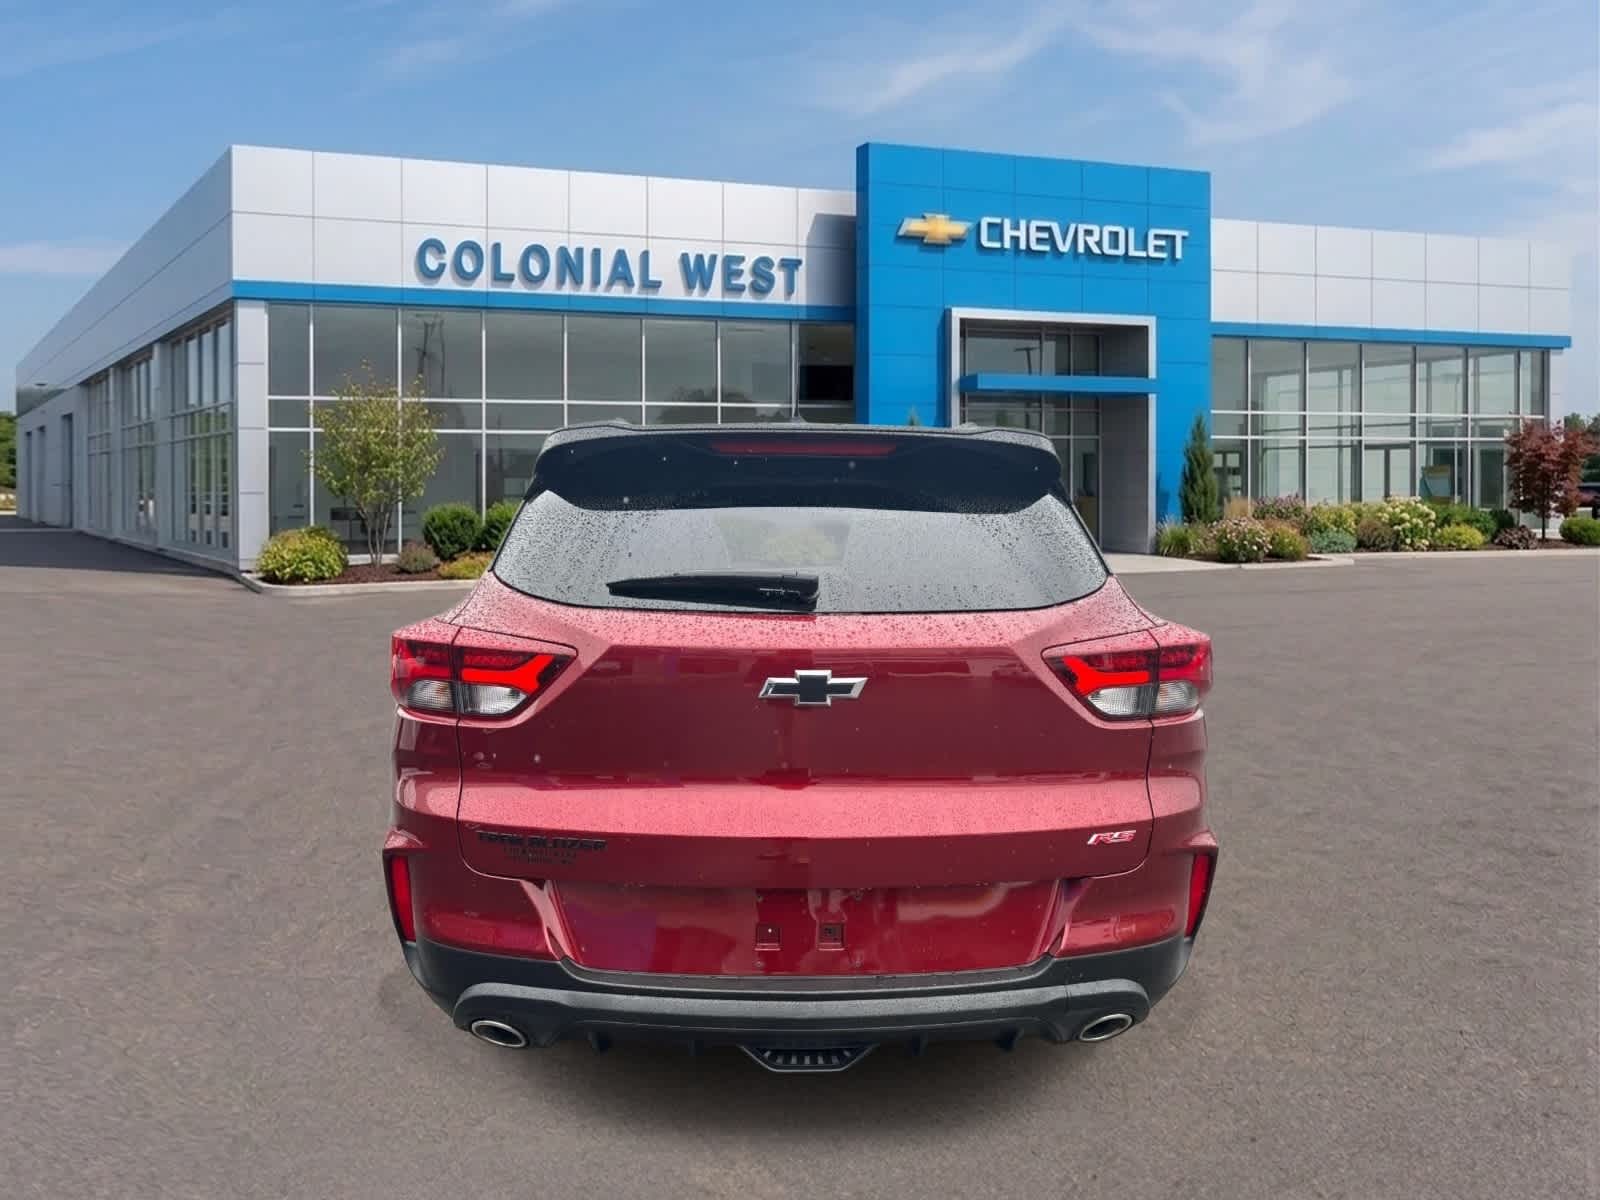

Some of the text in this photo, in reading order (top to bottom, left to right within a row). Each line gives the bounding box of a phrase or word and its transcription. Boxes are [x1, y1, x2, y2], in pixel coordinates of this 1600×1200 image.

[980, 216, 1189, 260] CHEVROLET
[415, 237, 803, 295] COLONIAL WEST
[1087, 829, 1137, 845] RS
